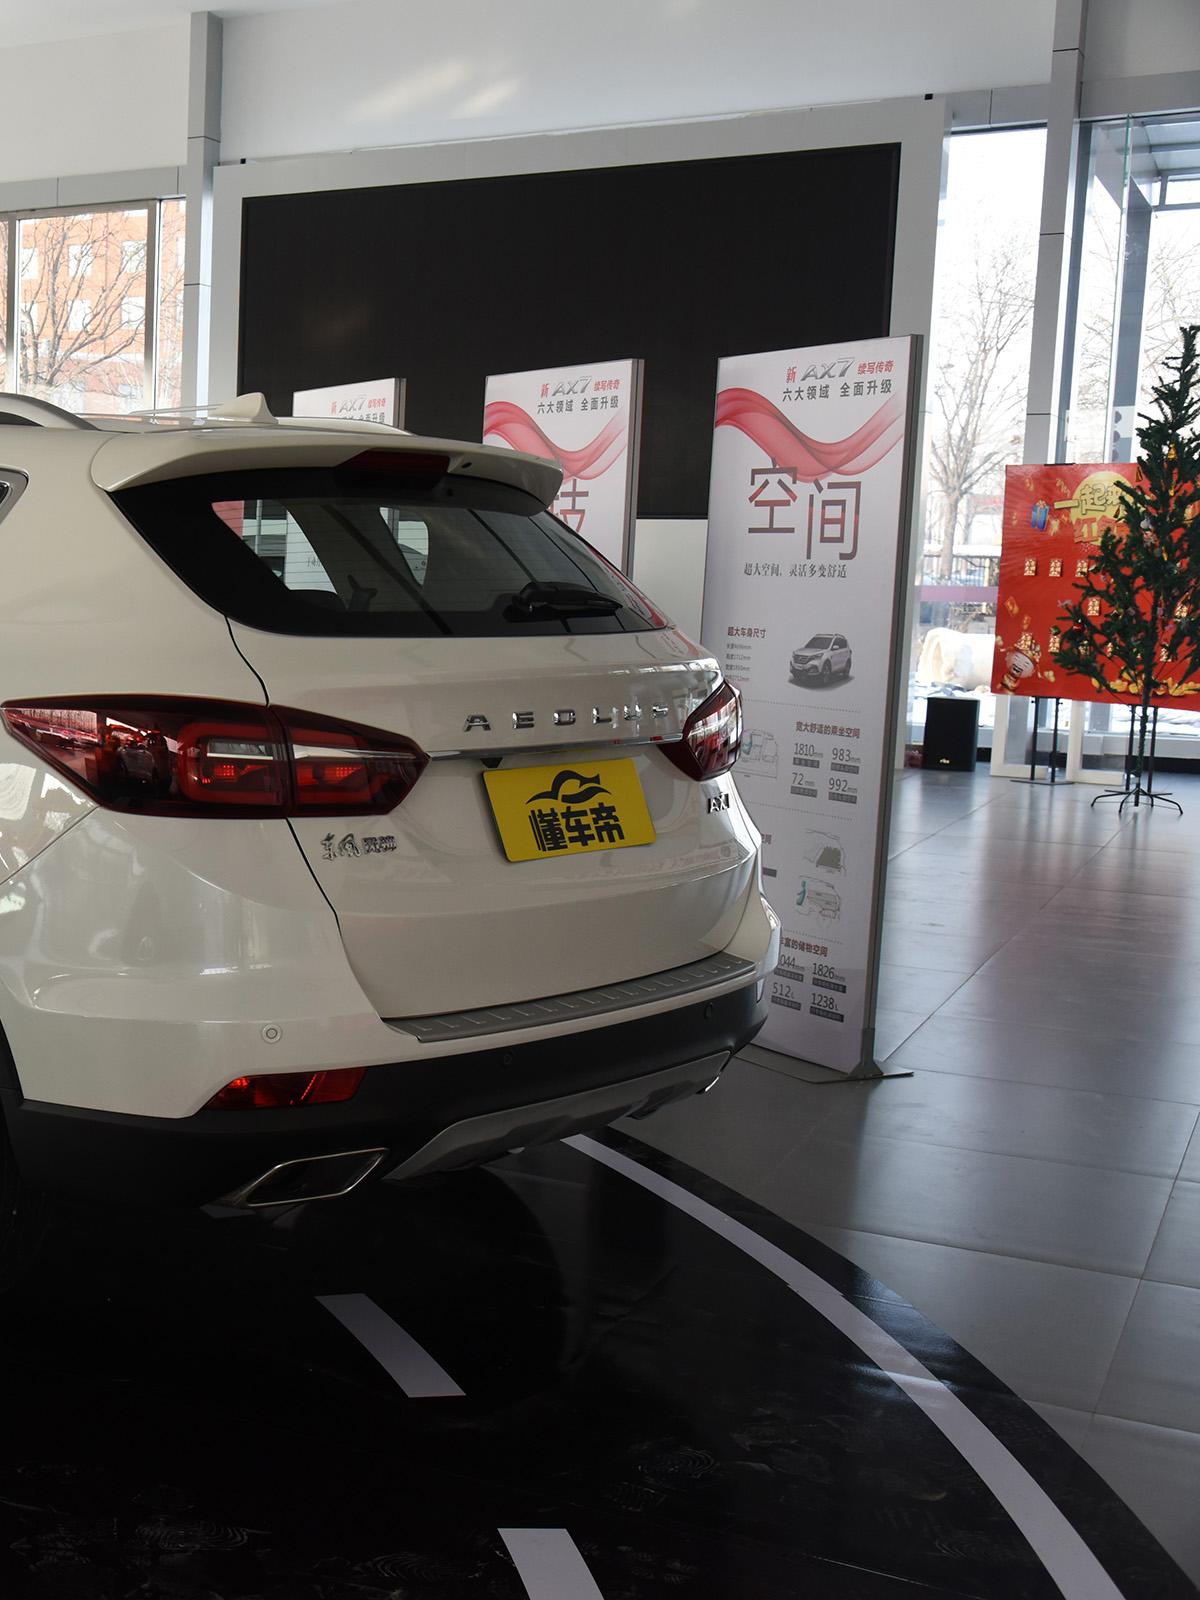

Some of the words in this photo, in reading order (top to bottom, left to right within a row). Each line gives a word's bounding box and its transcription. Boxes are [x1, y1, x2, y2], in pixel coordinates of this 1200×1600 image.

[785, 366, 797, 384] 新
[800, 357, 855, 381] AX7
[857, 360, 894, 375] 续写传奇
[540, 383, 549, 398] 新
[552, 375, 592, 396] AX7
[782, 386, 830, 402] 六大领域
[840, 378, 892, 398] 全面升级
[537, 400, 574, 414] 六大领域
[580, 395, 619, 411] 全面升级
[748, 457, 862, 560] 空间
[528, 802, 625, 852] 懂车帝
